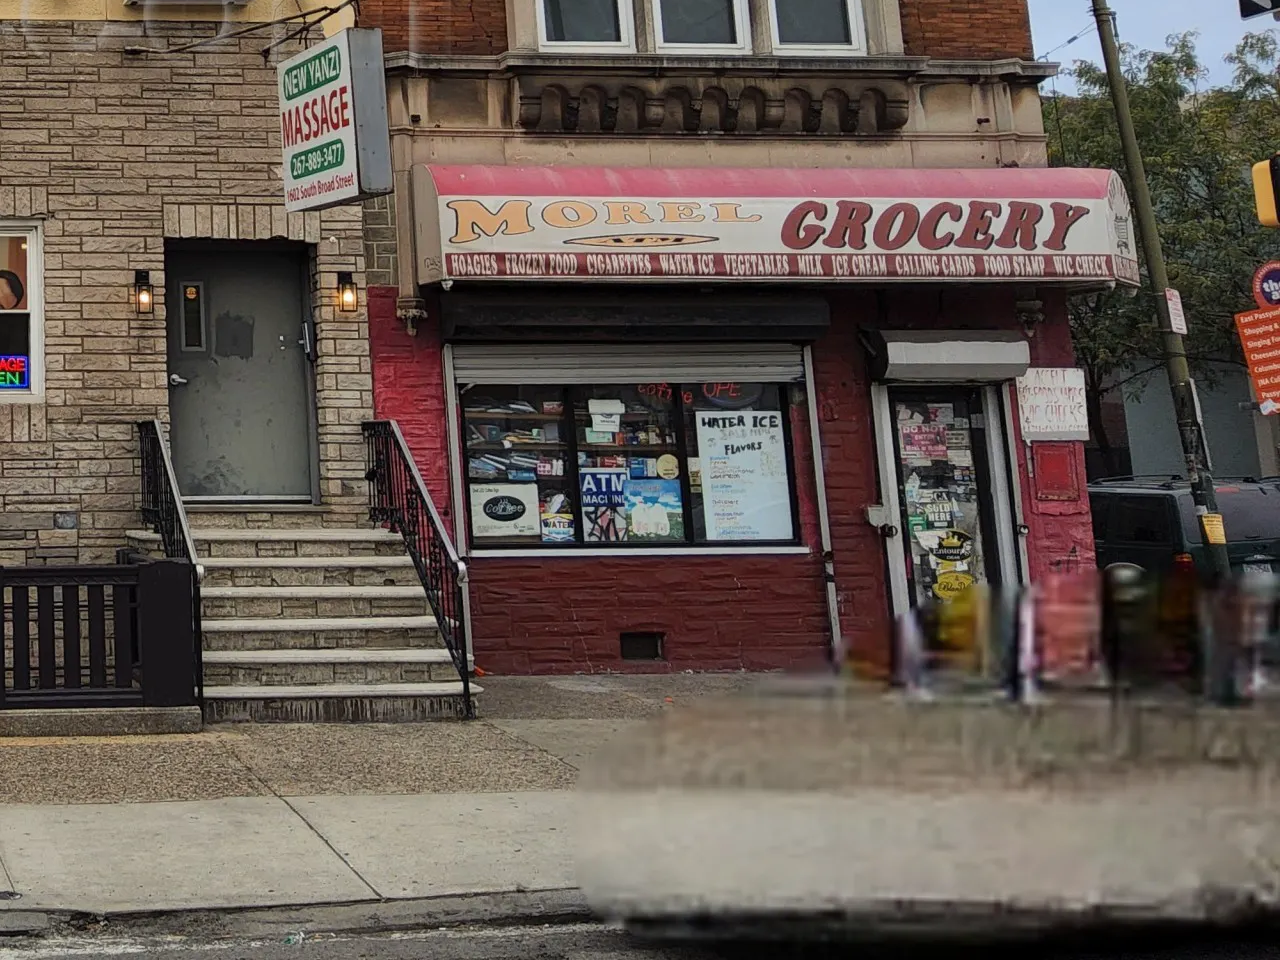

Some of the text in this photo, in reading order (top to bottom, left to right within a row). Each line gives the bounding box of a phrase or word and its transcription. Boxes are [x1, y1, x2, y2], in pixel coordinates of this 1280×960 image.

[284, 50, 340, 97] NEW YANZI
[282, 85, 350, 150] MASSAGE
[292, 144, 342, 176] 267-889-3477
[287, 172, 355, 203] 1602 South Broad Street
[446, 199, 763, 244] MOREL
[780, 199, 1092, 253] GROCERY
[451, 254, 498, 276] HOAGIES
[505, 254, 547, 276] FROZEN
[549, 254, 578, 276] FOOD
[586, 254, 652, 276] CIGARETTES
[659, 254, 696, 275] WATER
[696, 254, 716, 275] ICE
[723, 253, 789, 276] VEGETABLES
[797, 253, 824, 276] MILK
[832, 253, 851, 276] ICE
[851, 253, 888, 276] CREAM
[895, 253, 939, 276] CALLING
[941, 253, 974, 276] CARDS
[983, 253, 1011, 276] FOOD
[1013, 253, 1045, 276] STAMP
[1053, 253, 1076, 276] WIC
[1079, 253, 1109, 277] CHECK
[1240, 315, 1254, 323] East
[1243, 324, 1274, 335] Shopping
[1247, 338, 1272, 348] Singing
[701, 415, 779, 428] WATER ICE
[922, 425, 945, 433] NOT
[724, 441, 763, 455] FLAVORS
[582, 474, 626, 492] ATM
[926, 503, 950, 513] SOLD
[928, 512, 951, 521] HERE
